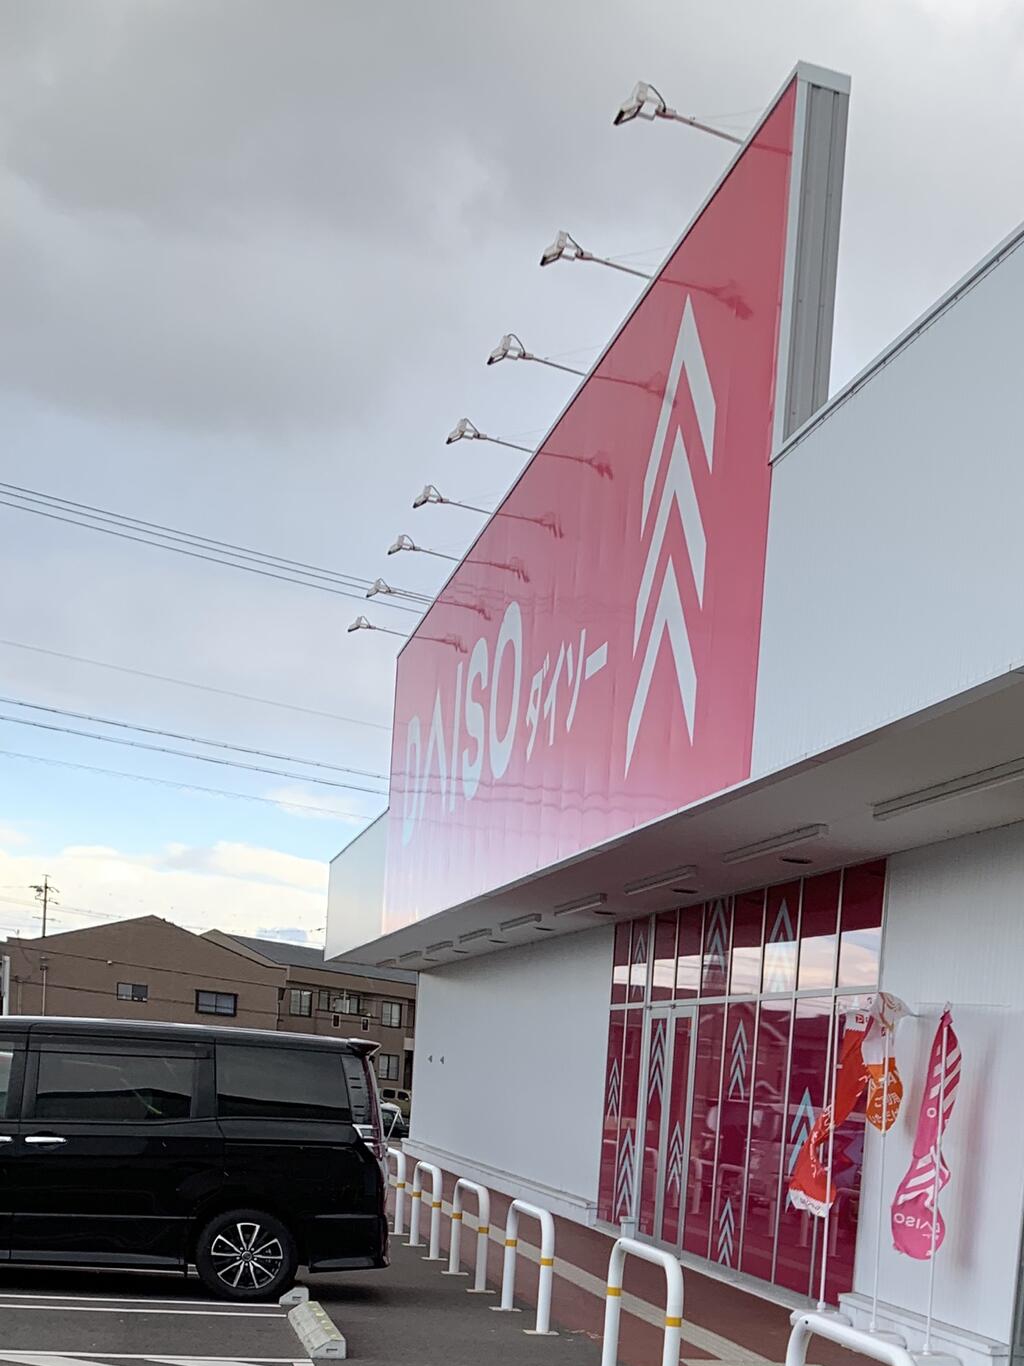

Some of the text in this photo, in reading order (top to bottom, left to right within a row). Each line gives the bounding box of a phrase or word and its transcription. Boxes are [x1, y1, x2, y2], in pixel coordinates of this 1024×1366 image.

[402, 601, 523, 848] DAISO
[525, 626, 609, 764] ダイソー
